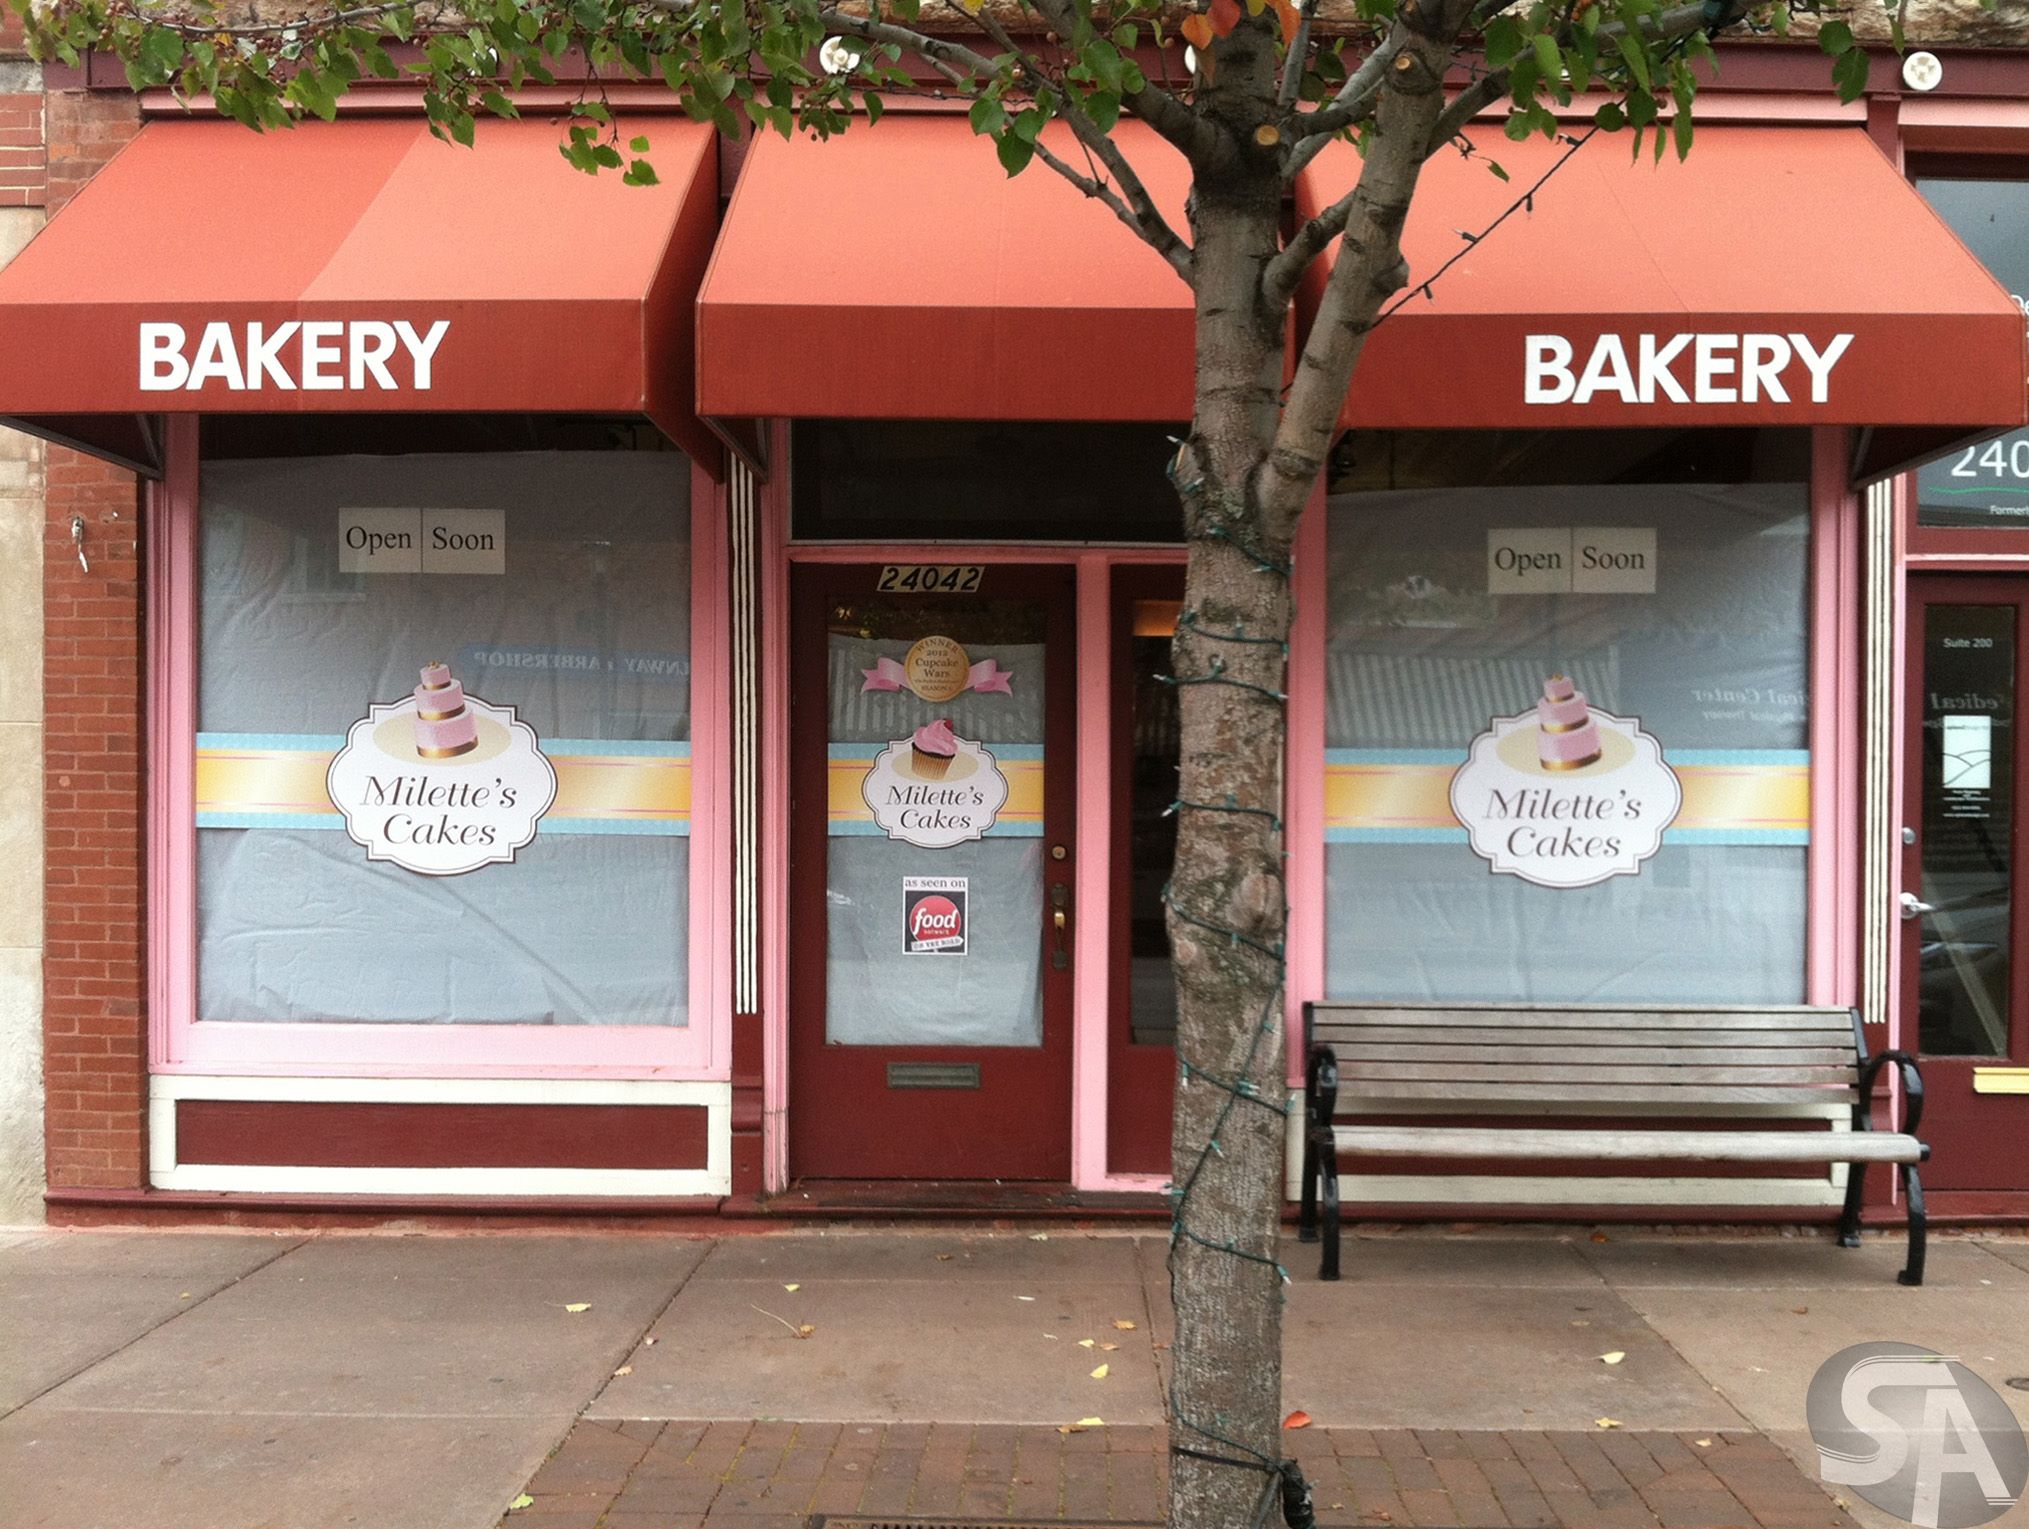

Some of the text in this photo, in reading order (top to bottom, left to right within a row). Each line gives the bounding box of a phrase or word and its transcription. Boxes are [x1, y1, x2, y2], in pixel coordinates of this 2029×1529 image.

[138, 320, 451, 392] BAKERY
[1523, 332, 1856, 405] BAKERY
[1951, 440, 2029, 478] 240
[345, 525, 495, 556] Open Soon
[1494, 546, 1646, 577] Open Soon
[879, 566, 980, 591] 24042
[1942, 637, 1993, 648] Suite 200
[915, 658, 960, 669] Cupcake
[923, 668, 951, 678] Wars
[360, 775, 518, 810] Milette's
[885, 783, 985, 807] Milette's
[1483, 787, 1643, 822] Milette's
[382, 813, 498, 848] Cakes
[899, 808, 972, 831] Cakes
[1505, 825, 1622, 860] Cakes
[905, 879, 966, 888] as seen on
[912, 908, 959, 935] food
